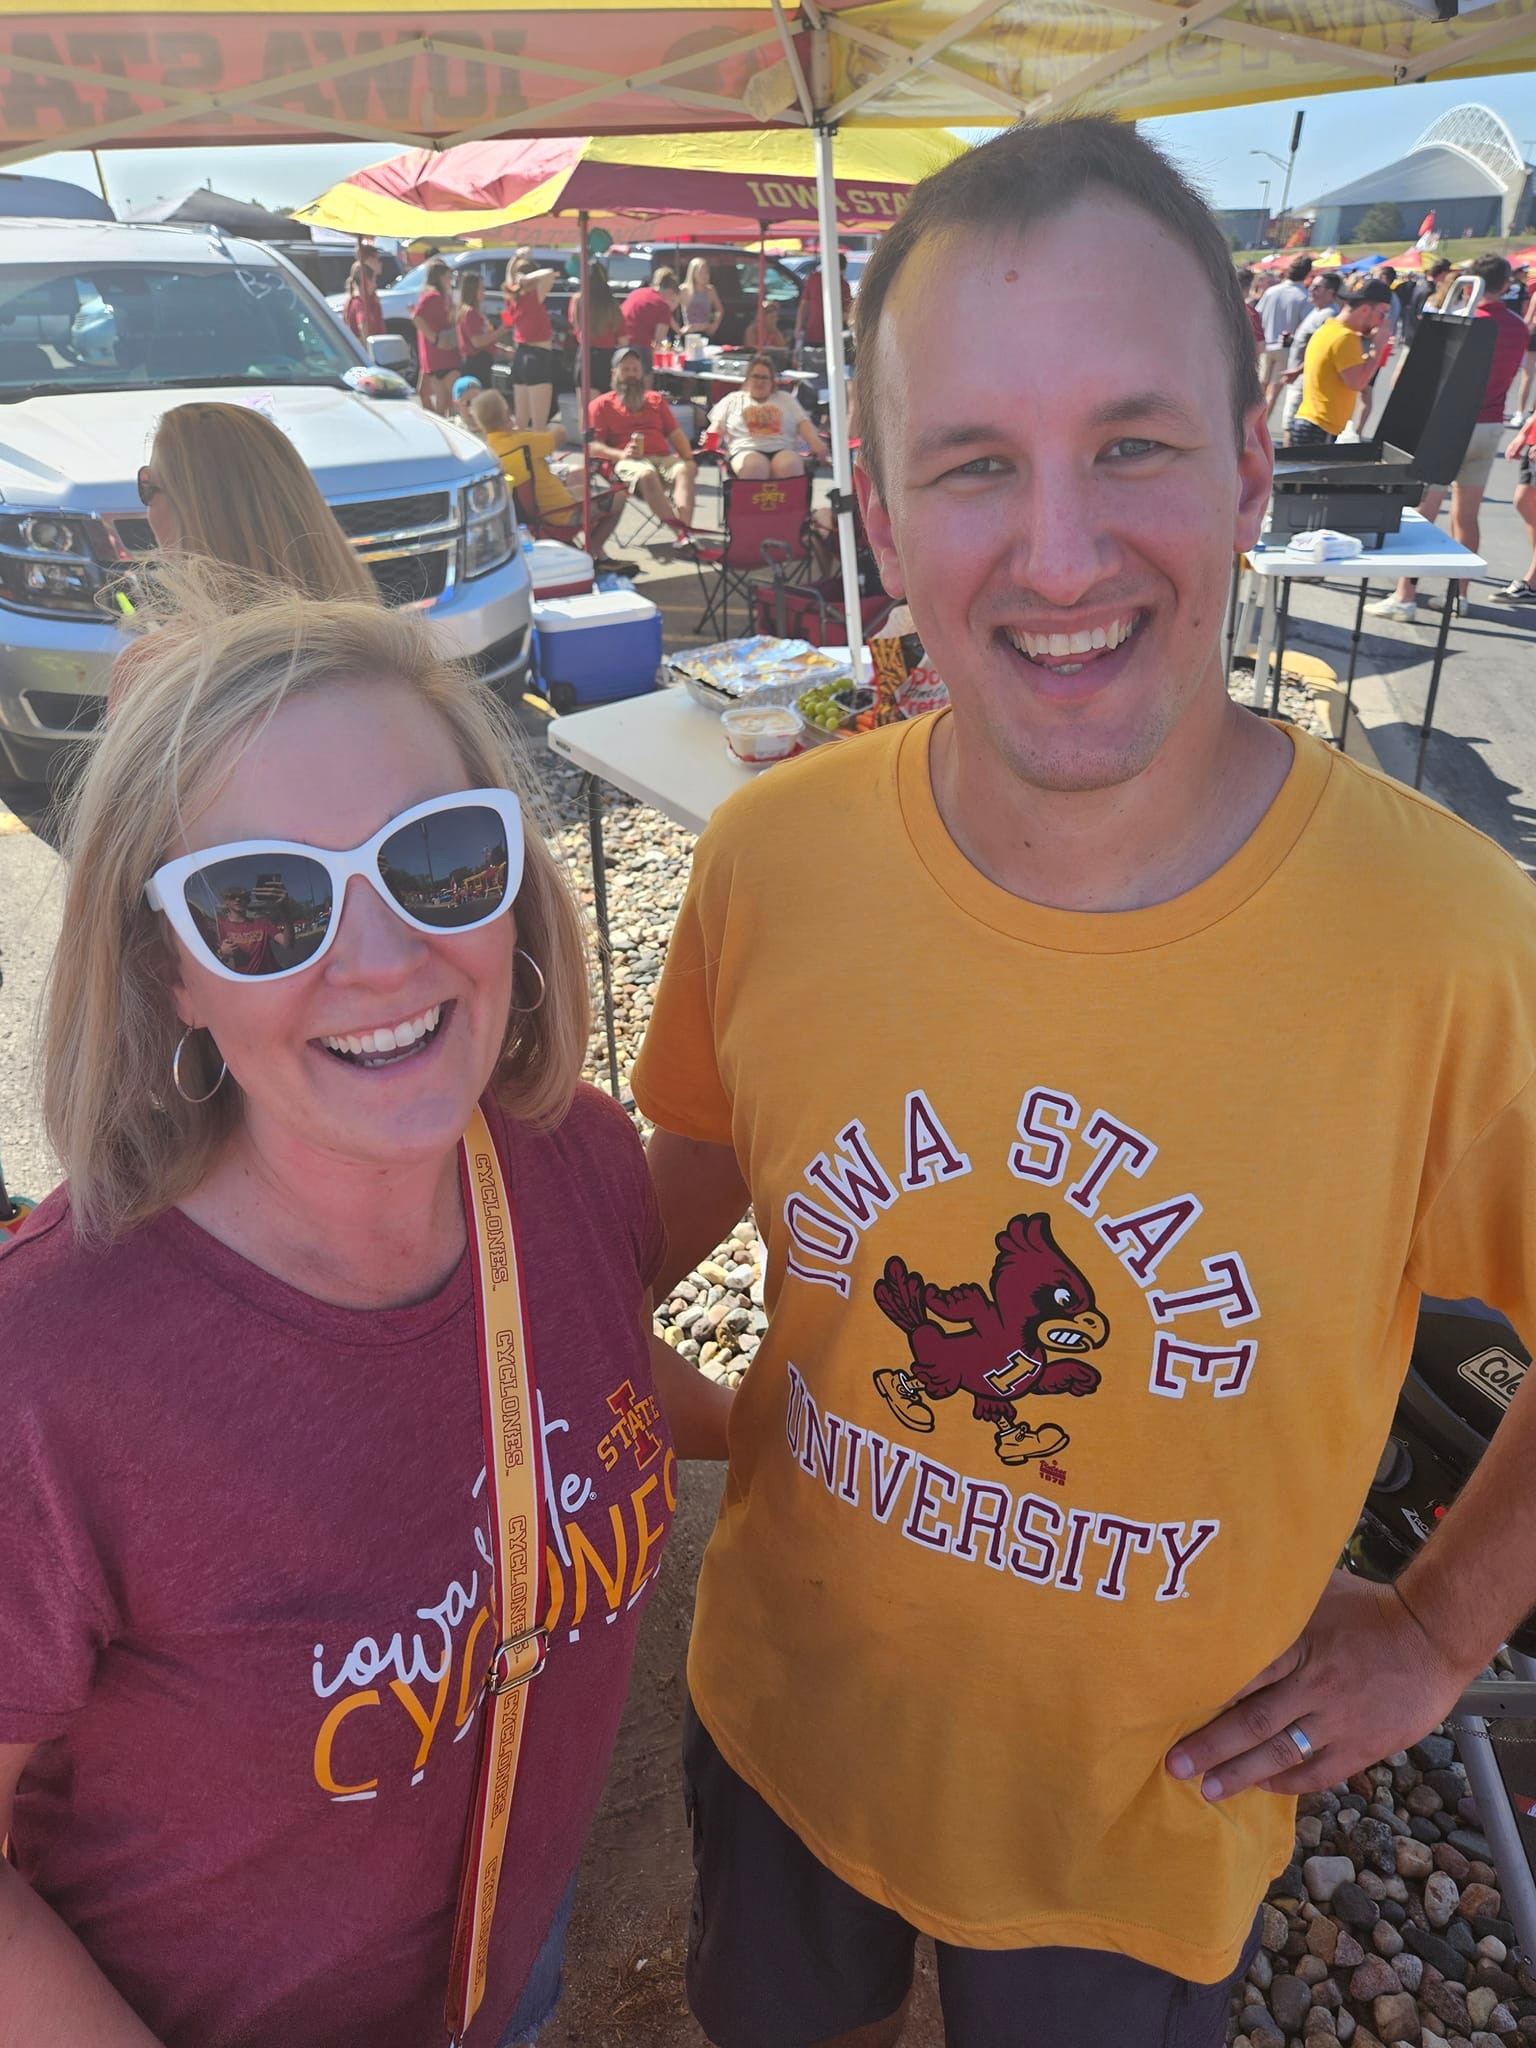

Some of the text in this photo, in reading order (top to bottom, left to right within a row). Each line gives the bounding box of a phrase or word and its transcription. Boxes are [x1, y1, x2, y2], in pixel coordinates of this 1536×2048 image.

[475, 1153, 508, 1285] CYCLONES
[784, 1086, 1261, 1399] IOWA STATE
[496, 1330, 523, 1469] CYCLONES
[597, 1395, 660, 1473] STATE
[787, 1361, 1219, 1601] UNIVERSITY
[313, 1570, 478, 1698] iowa
[492, 1689, 520, 1820] CYCLONES
